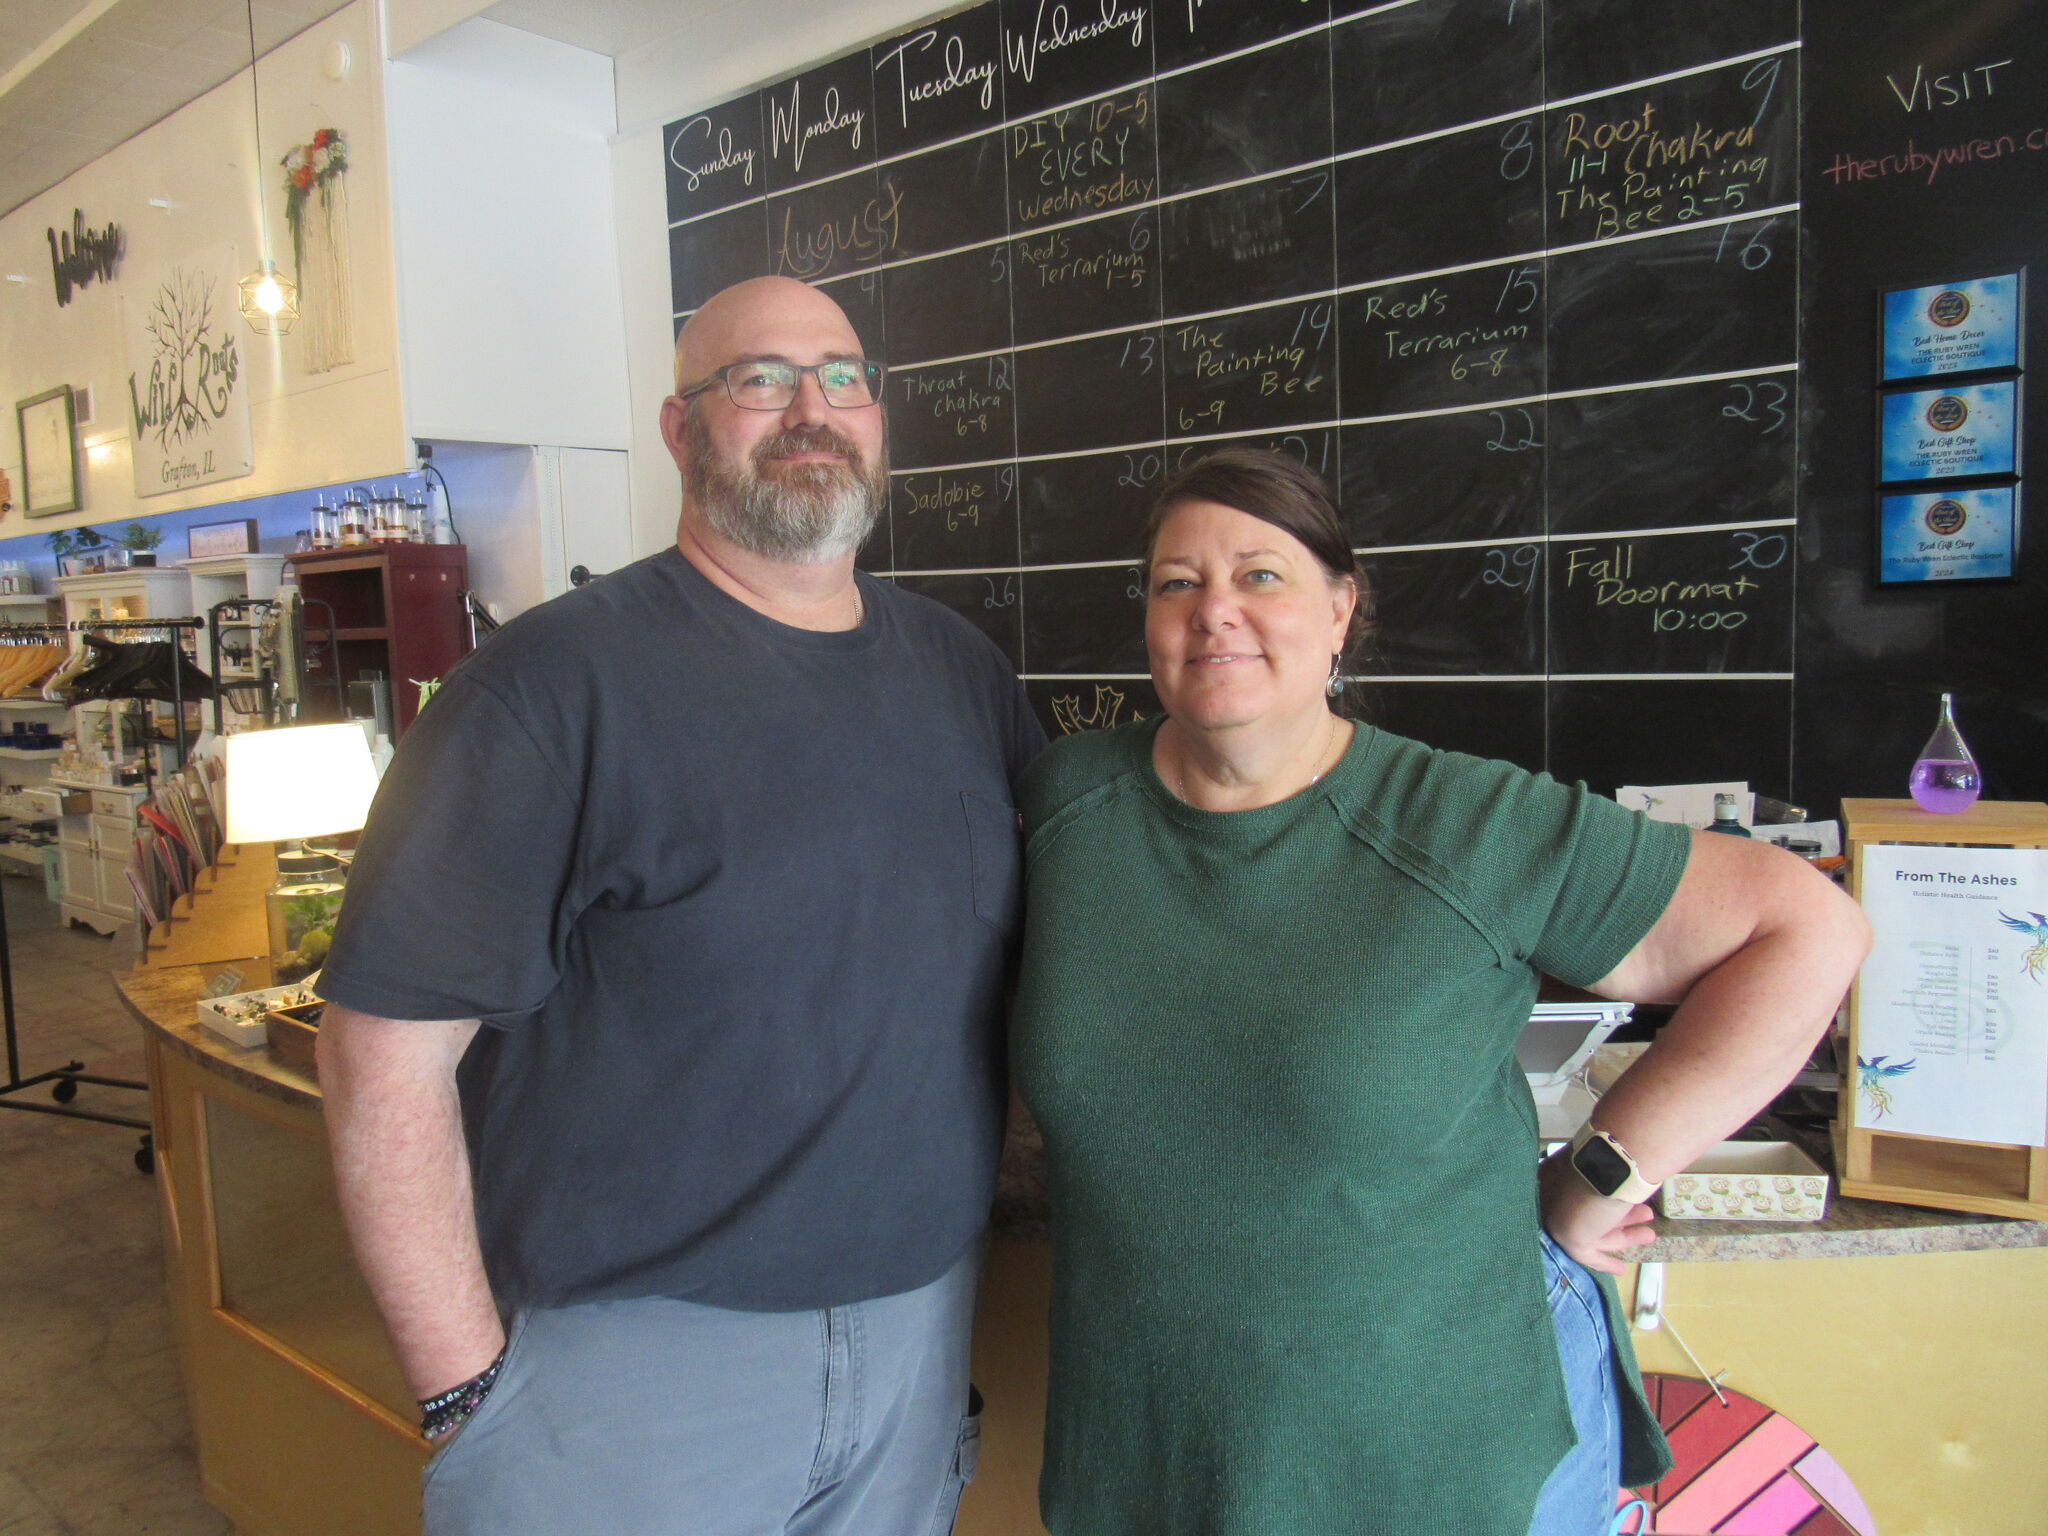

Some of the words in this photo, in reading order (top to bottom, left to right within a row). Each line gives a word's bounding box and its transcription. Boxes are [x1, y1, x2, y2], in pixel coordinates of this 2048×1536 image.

[1006, 0, 1147, 82] Wednesday
[875, 31, 997, 128] Tuesday
[1741, 57, 1782, 128] 9
[1886, 58, 2013, 112] VISIT
[771, 81, 864, 172] Monday
[1014, 111, 1069, 159] DIY
[1089, 92, 1148, 132] 10-5
[1564, 103, 1655, 157] Root
[671, 117, 755, 190] Sunday
[1040, 126, 1130, 185] EVERY
[1500, 120, 1533, 180] 8
[1624, 121, 1754, 174] Chakra
[1822, 129, 2048, 185] therubywren.c
[1291, 172, 1328, 214] 7
[1556, 184, 1611, 218] The
[1595, 204, 1663, 240] Bee
[1677, 183, 1749, 220] 2-5
[776, 181, 905, 280] August
[1018, 233, 1070, 264] Red's
[1130, 211, 1150, 251] 6
[1715, 216, 1777, 270] 16
[989, 246, 1006, 283] 5
[1039, 249, 1144, 287] Terrarium
[860, 274, 875, 305] 4
[1365, 288, 1448, 323] Red's
[1496, 268, 1540, 312] 15
[1177, 319, 1224, 350] The
[1291, 304, 1331, 350] 14
[1385, 321, 1529, 359] Terrarium
[987, 356, 1012, 391] 12
[1119, 337, 1155, 376] 13
[1197, 345, 1305, 378] Painting
[1450, 349, 1508, 381] 6-8
[129, 358, 178, 441] Wild
[197, 332, 240, 419] Roots
[903, 370, 967, 402] Throat
[1260, 371, 1323, 396] Bee
[957, 414, 988, 436] 6-8
[1179, 399, 1225, 431] 6-9
[1722, 381, 1788, 434] 23
[1486, 408, 1544, 452] 22
[161, 456, 200, 488] Grafton,
[203, 451, 216, 474] IL
[994, 465, 1014, 503] 19
[1118, 454, 1160, 488] 20
[947, 504, 979, 532] 6-9
[1483, 544, 1540, 595] 29
[1567, 544, 1633, 588] Fall
[1728, 532, 1788, 570] 30
[984, 575, 1015, 609] 26
[1127, 567, 1146, 599] 2
[1593, 575, 1760, 606] Doormat
[1653, 608, 1748, 633] 10:00
[1896, 870, 1933, 882] From
[1939, 872, 1966, 884] The
[1971, 874, 2018, 886] Ashes
